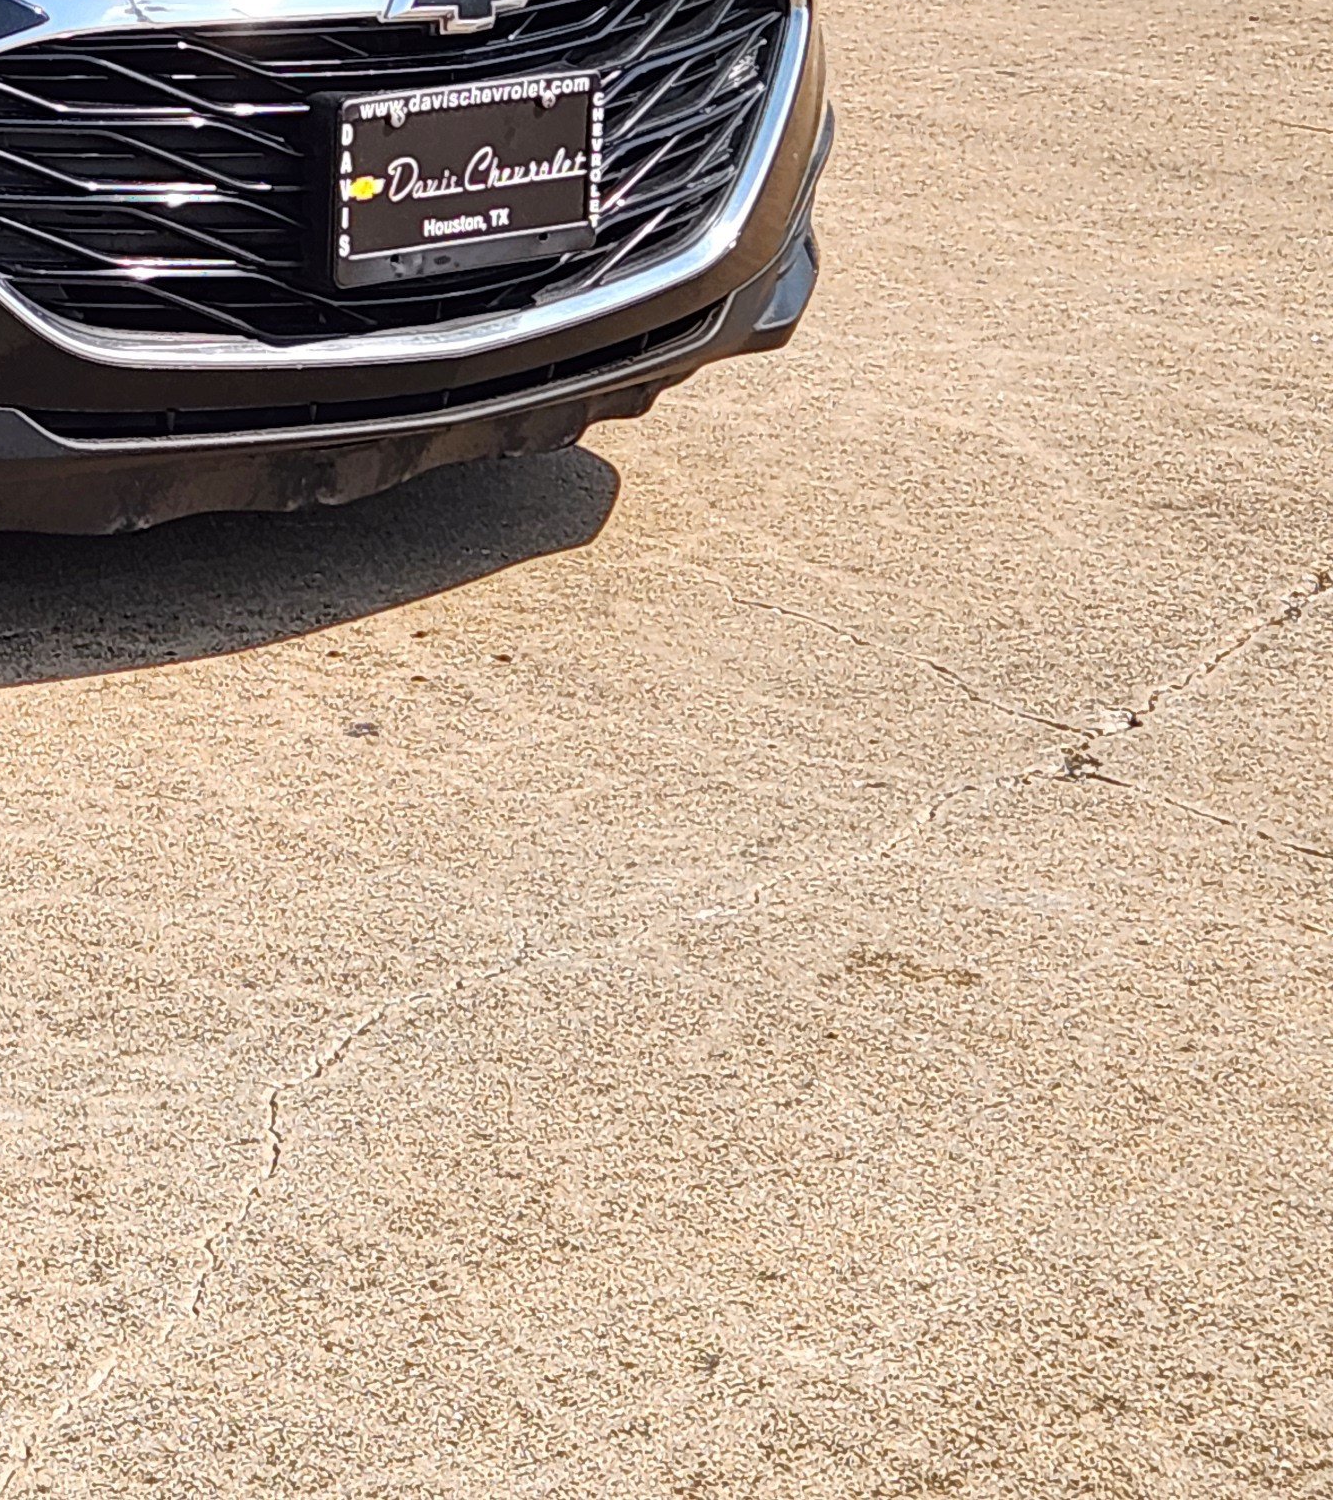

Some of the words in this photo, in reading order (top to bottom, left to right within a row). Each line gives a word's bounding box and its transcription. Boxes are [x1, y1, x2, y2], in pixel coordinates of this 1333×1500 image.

[359, 76, 590, 120] www.davischevrolet.com
[388, 156, 461, 202] Davis
[464, 145, 588, 192] Chevrolet
[588, 91, 604, 229] CHEVROLET
[338, 122, 354, 258] DAVIS
[423, 213, 487, 238] Houston,
[489, 207, 509, 228] TX
